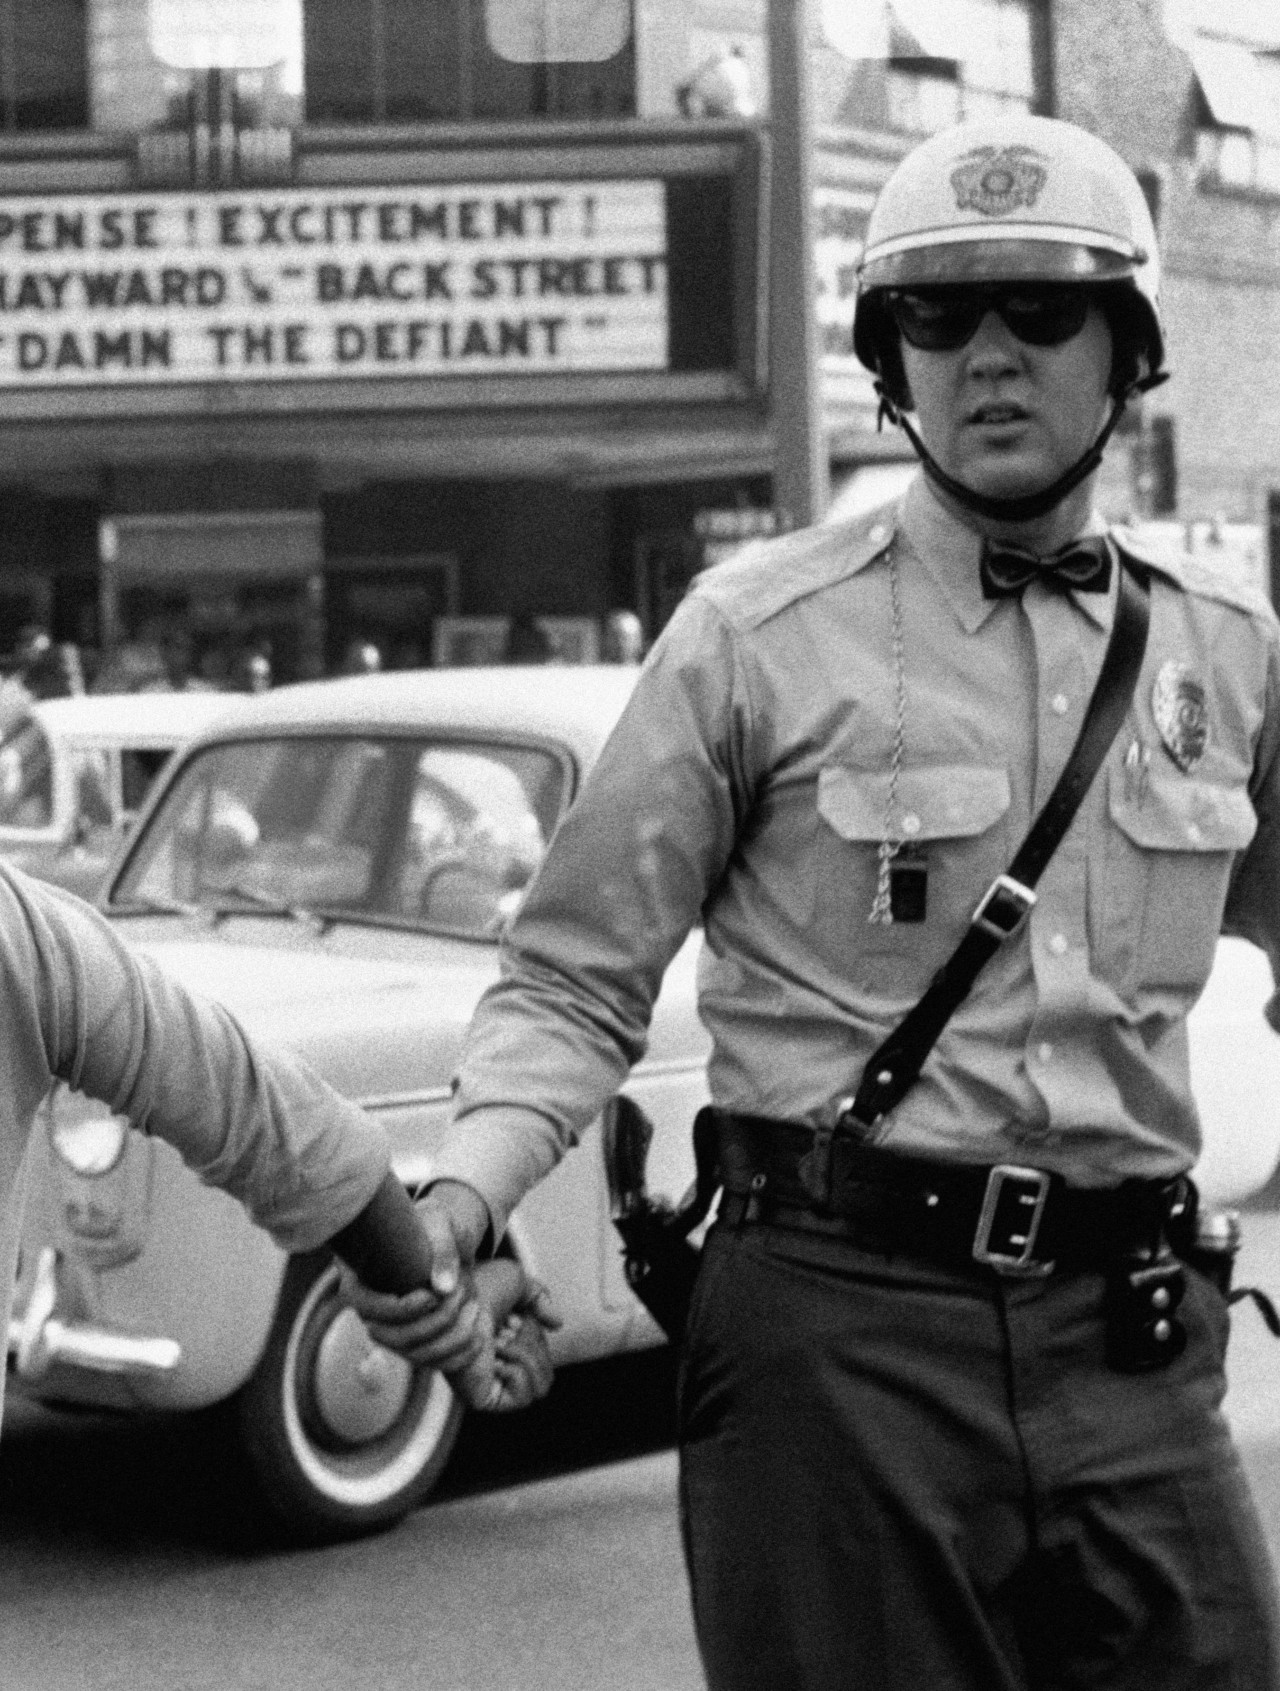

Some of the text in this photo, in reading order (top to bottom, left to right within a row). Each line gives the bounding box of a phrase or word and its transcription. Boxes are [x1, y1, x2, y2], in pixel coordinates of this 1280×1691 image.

[219, 198, 562, 246] EXCITEMENT
[470, 254, 668, 298] STREET
[207, 321, 310, 366] THE
